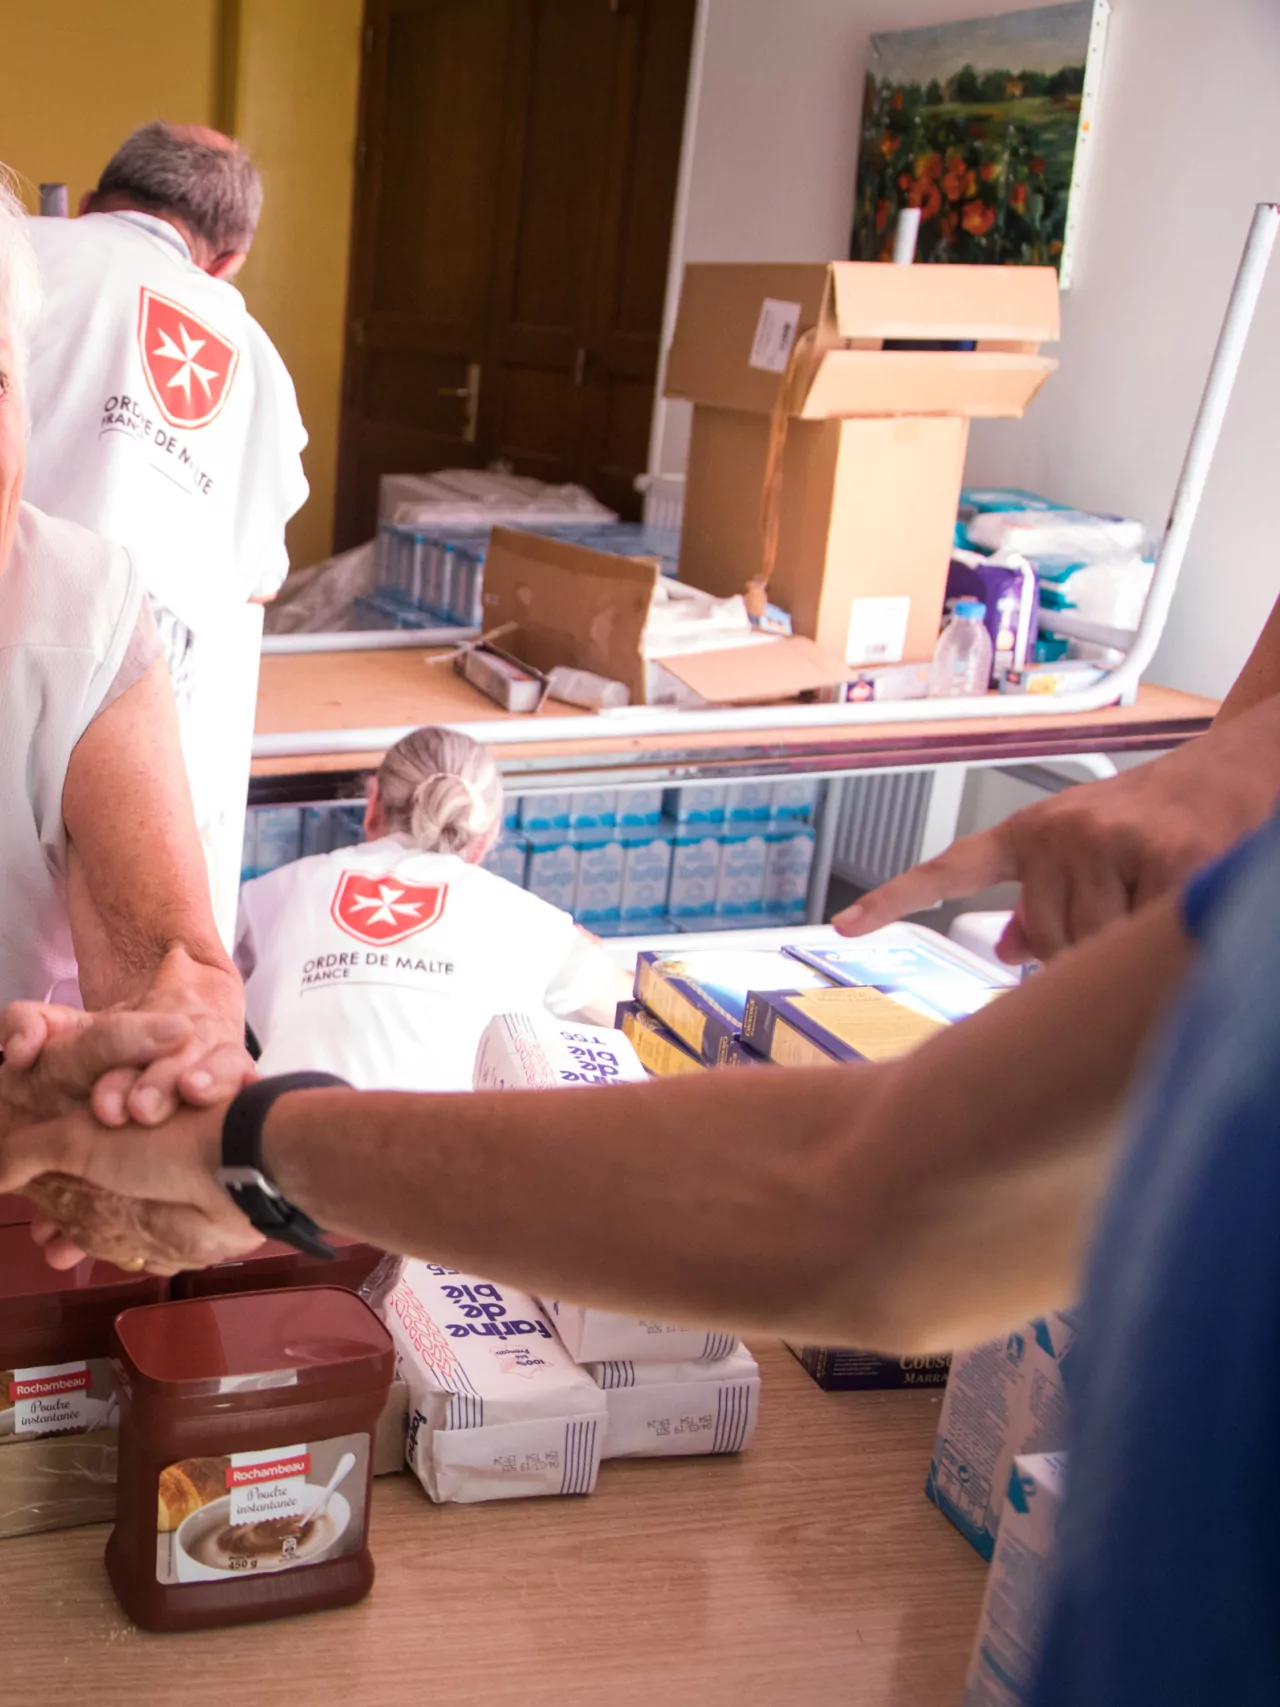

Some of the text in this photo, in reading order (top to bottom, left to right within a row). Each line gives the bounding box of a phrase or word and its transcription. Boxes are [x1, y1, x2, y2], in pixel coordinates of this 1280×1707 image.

[154, 429, 177, 453] DE
[303, 952, 455, 975] ORDRE DE MALTE
[301, 967, 350, 985] FRANCE
[560, 1031, 607, 1046] T55
[566, 1045, 619, 1067] blé
[577, 1060, 619, 1077] de
[440, 1283, 504, 1304] blé
[458, 1302, 507, 1321] de
[445, 1319, 553, 1340] farine
[515, 1359, 545, 1367] 100%
[16, 1377, 86, 1395] Rochambeau
[30, 1397, 70, 1414] Poudre
[21, 1409, 80, 1426] instantanée
[233, 1462, 305, 1482] Rochambeau
[247, 1484, 287, 1501] Poudre
[236, 1498, 297, 1515] instantanée
[228, 1559, 258, 1570] 450 g
